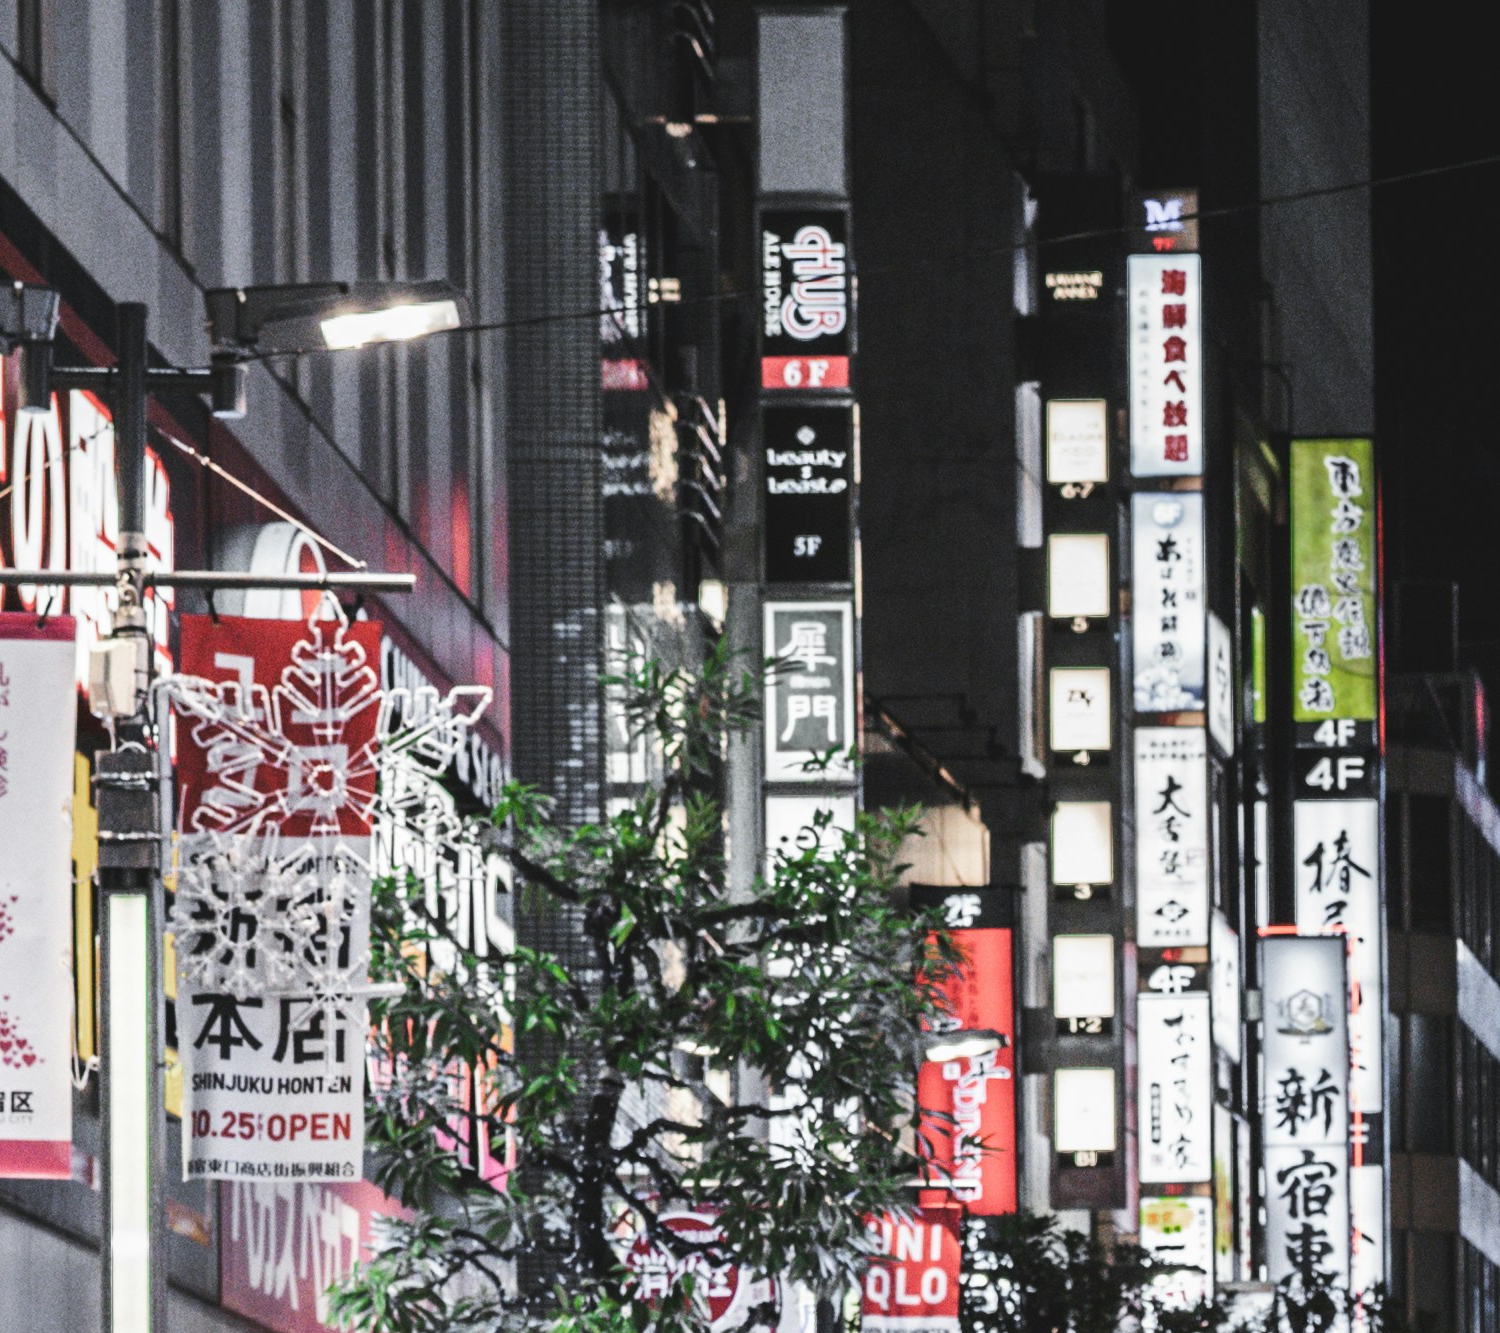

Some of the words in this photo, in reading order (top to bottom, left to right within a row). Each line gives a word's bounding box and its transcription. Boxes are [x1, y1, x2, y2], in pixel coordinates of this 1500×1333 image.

[783, 361, 829, 386] 6F
[1313, 720, 1356, 748] 4F
[1305, 757, 1365, 792] 4F
[191, 988, 350, 1068] 本店
[190, 1073, 272, 1097] SHINJUKU
[190, 1110, 256, 1143] 10.25
[266, 1110, 353, 1144] OPEN
[865, 1266, 948, 1311] QLO
